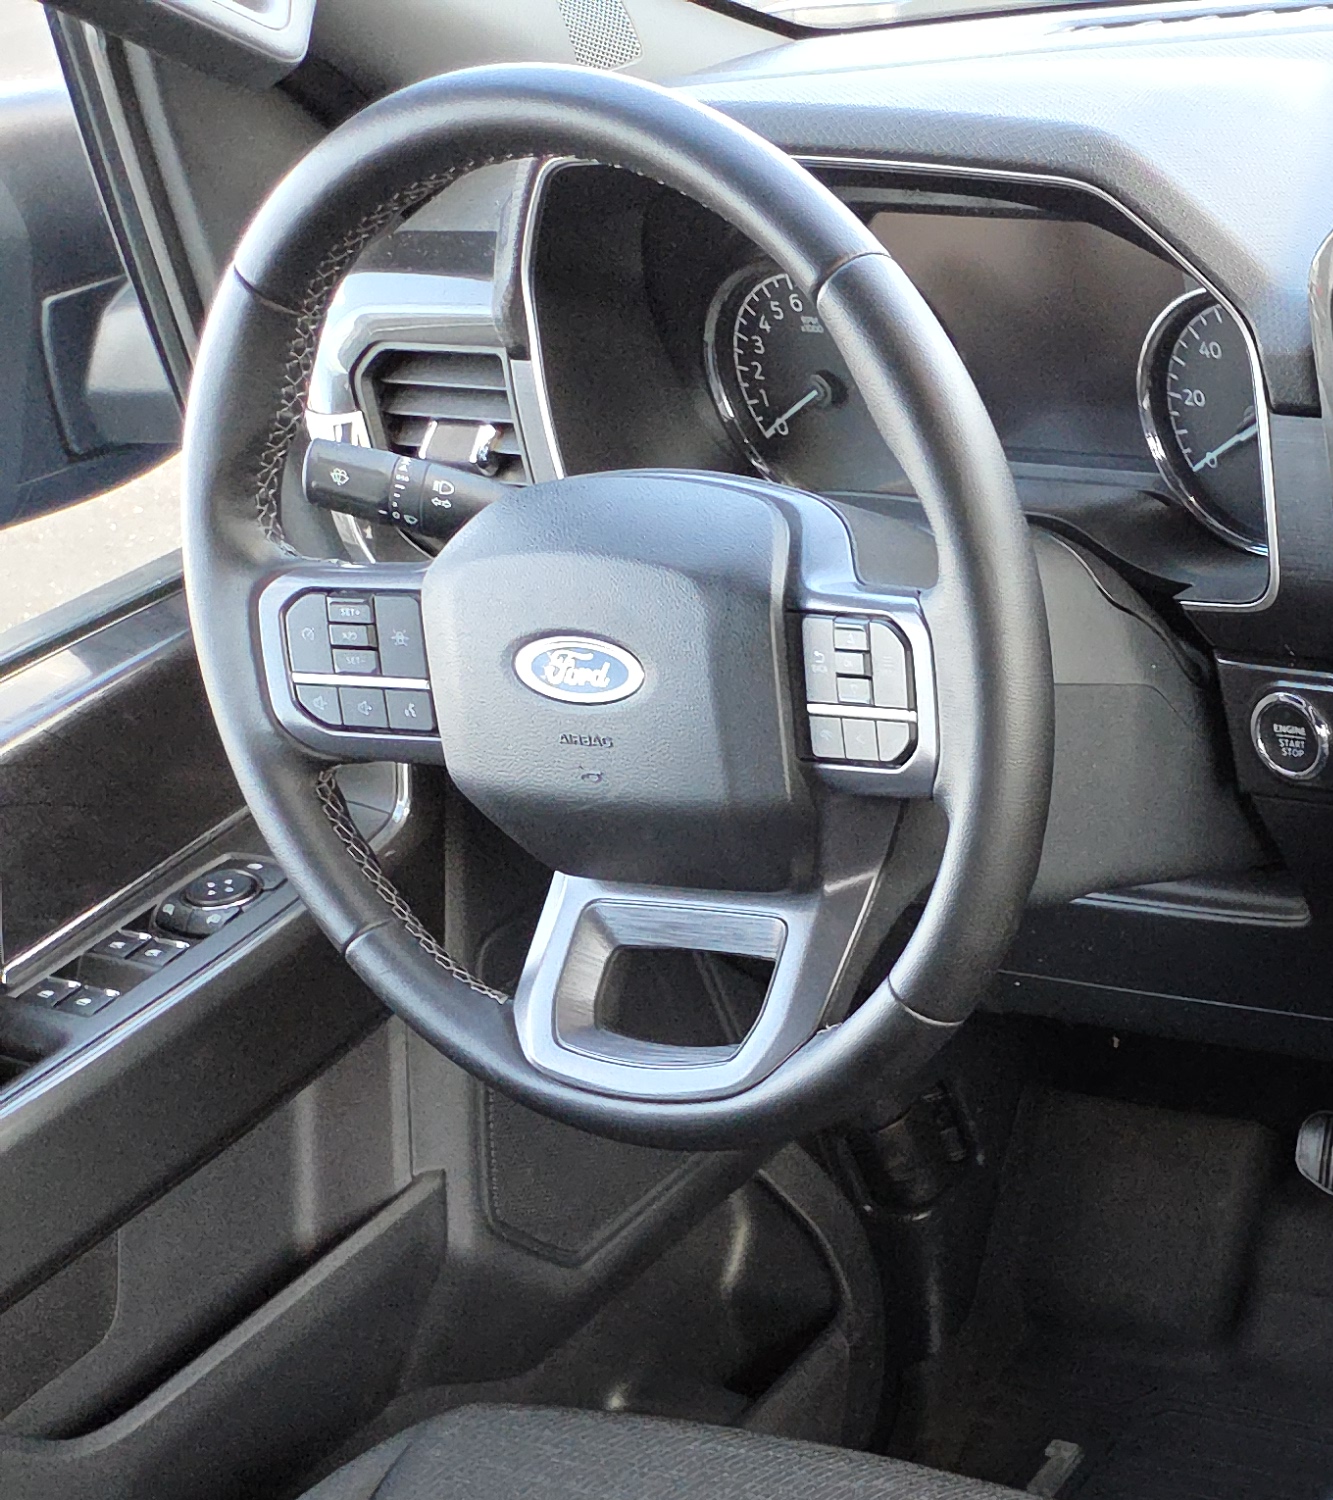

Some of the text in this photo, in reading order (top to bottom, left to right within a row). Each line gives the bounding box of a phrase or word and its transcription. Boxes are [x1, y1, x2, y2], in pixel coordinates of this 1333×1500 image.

[770, 300, 784, 320] 5
[788, 293, 803, 312] 6
[758, 314, 771, 333] 4
[751, 335, 765, 354] 3
[1198, 341, 1222, 360] 40
[751, 361, 765, 380] 2
[759, 388, 769, 407] 1
[1181, 388, 1206, 407] 20
[542, 648, 611, 688] Ford
[1273, 723, 1306, 736] ENGINE
[1279, 738, 1304, 748] START
[1282, 747, 1304, 757] STOP
